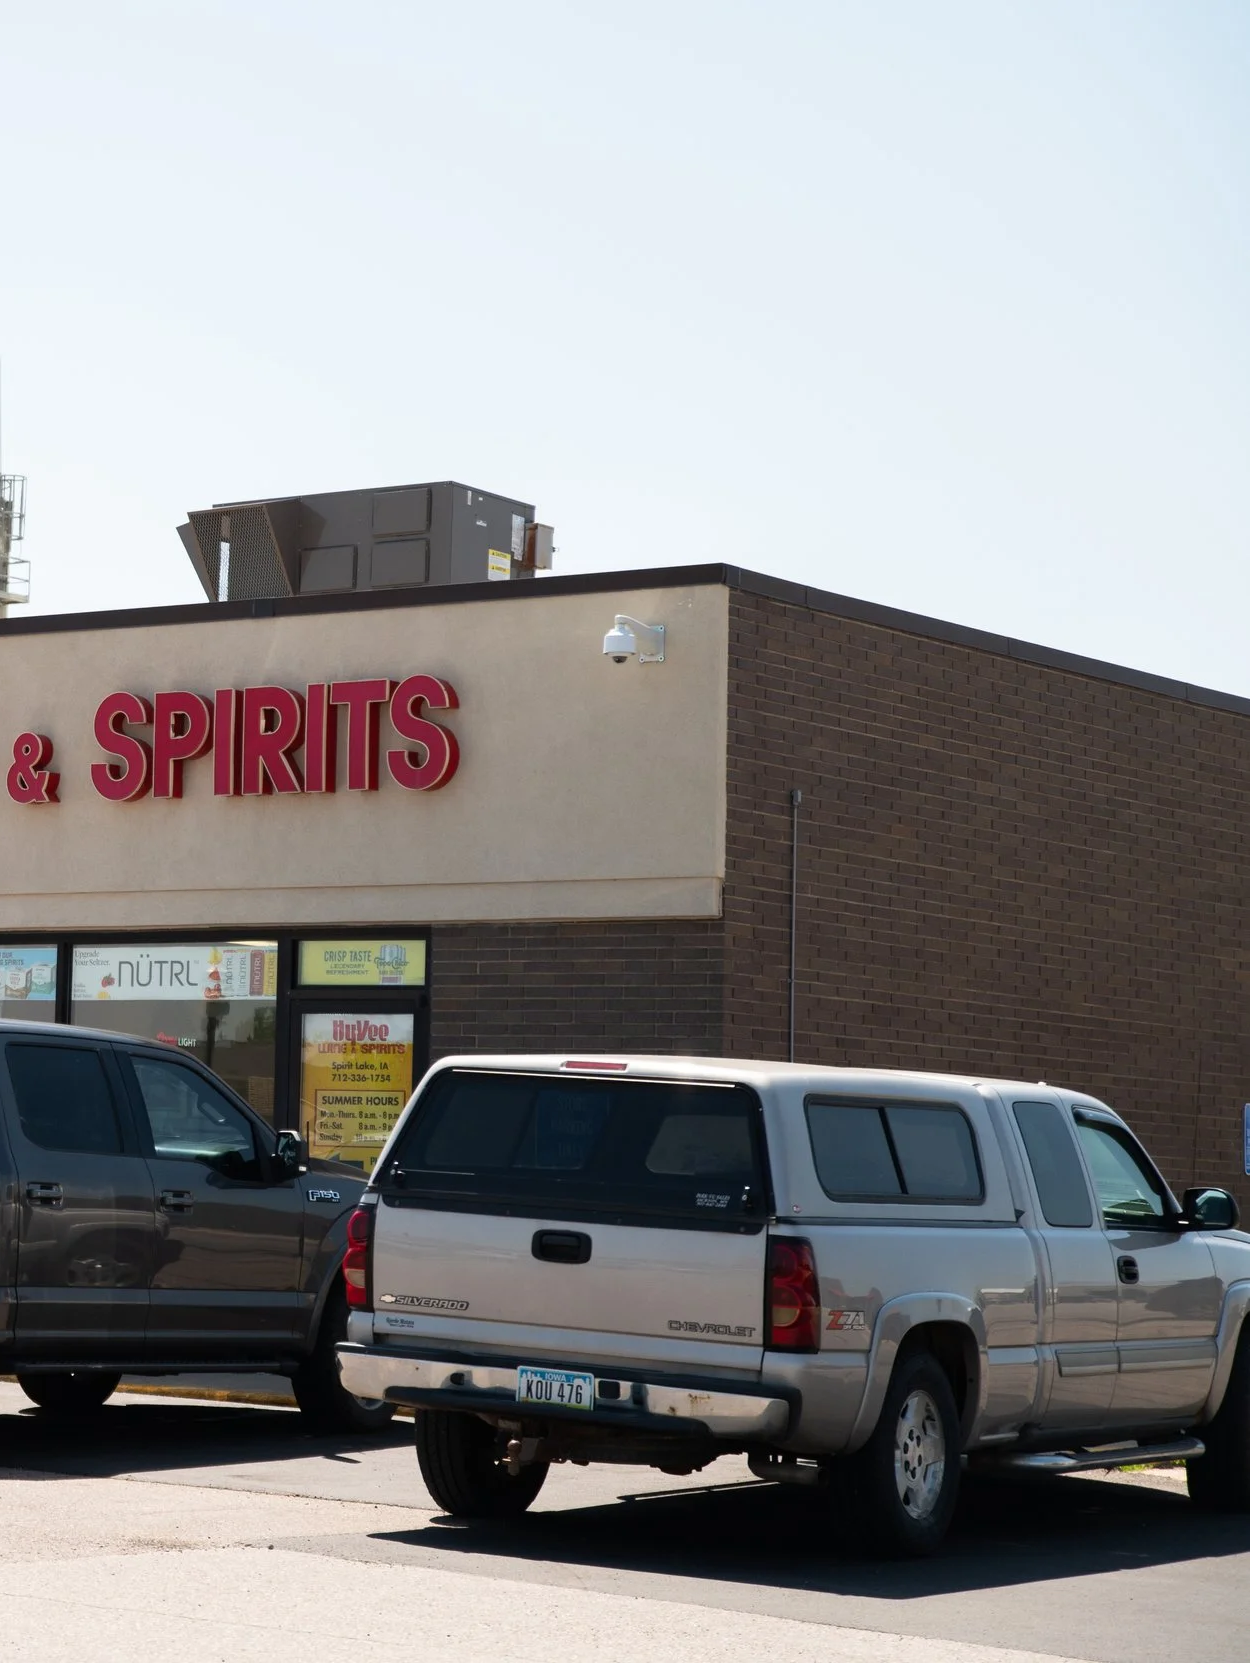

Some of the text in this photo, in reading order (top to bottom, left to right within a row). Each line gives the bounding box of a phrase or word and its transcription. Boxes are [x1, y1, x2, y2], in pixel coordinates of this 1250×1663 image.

[7, 732, 61, 803] &
[91, 674, 460, 801] SPIRITS
[74, 950, 100, 959] Upgrade
[324, 950, 372, 962] CRISP TASTE
[118, 953, 198, 987] NÜTRL
[332, 1019, 389, 1044] HyVee
[178, 1037, 197, 1047] LIGHT
[361, 1043, 406, 1054] SPIRITS
[332, 1062, 389, 1071] Spirit Lake, IA
[332, 1074, 391, 1082] 712-336-1754
[322, 1096, 400, 1106] SUMMER HOURS
[319, 1133, 342, 1142] Sunday
[396, 1296, 469, 1310] SILVERADO
[826, 1310, 866, 1330] Z71
[668, 1320, 756, 1337] CHEVROLET
[545, 1372, 567, 1382] IOWA
[526, 1379, 583, 1404] KOU 476
